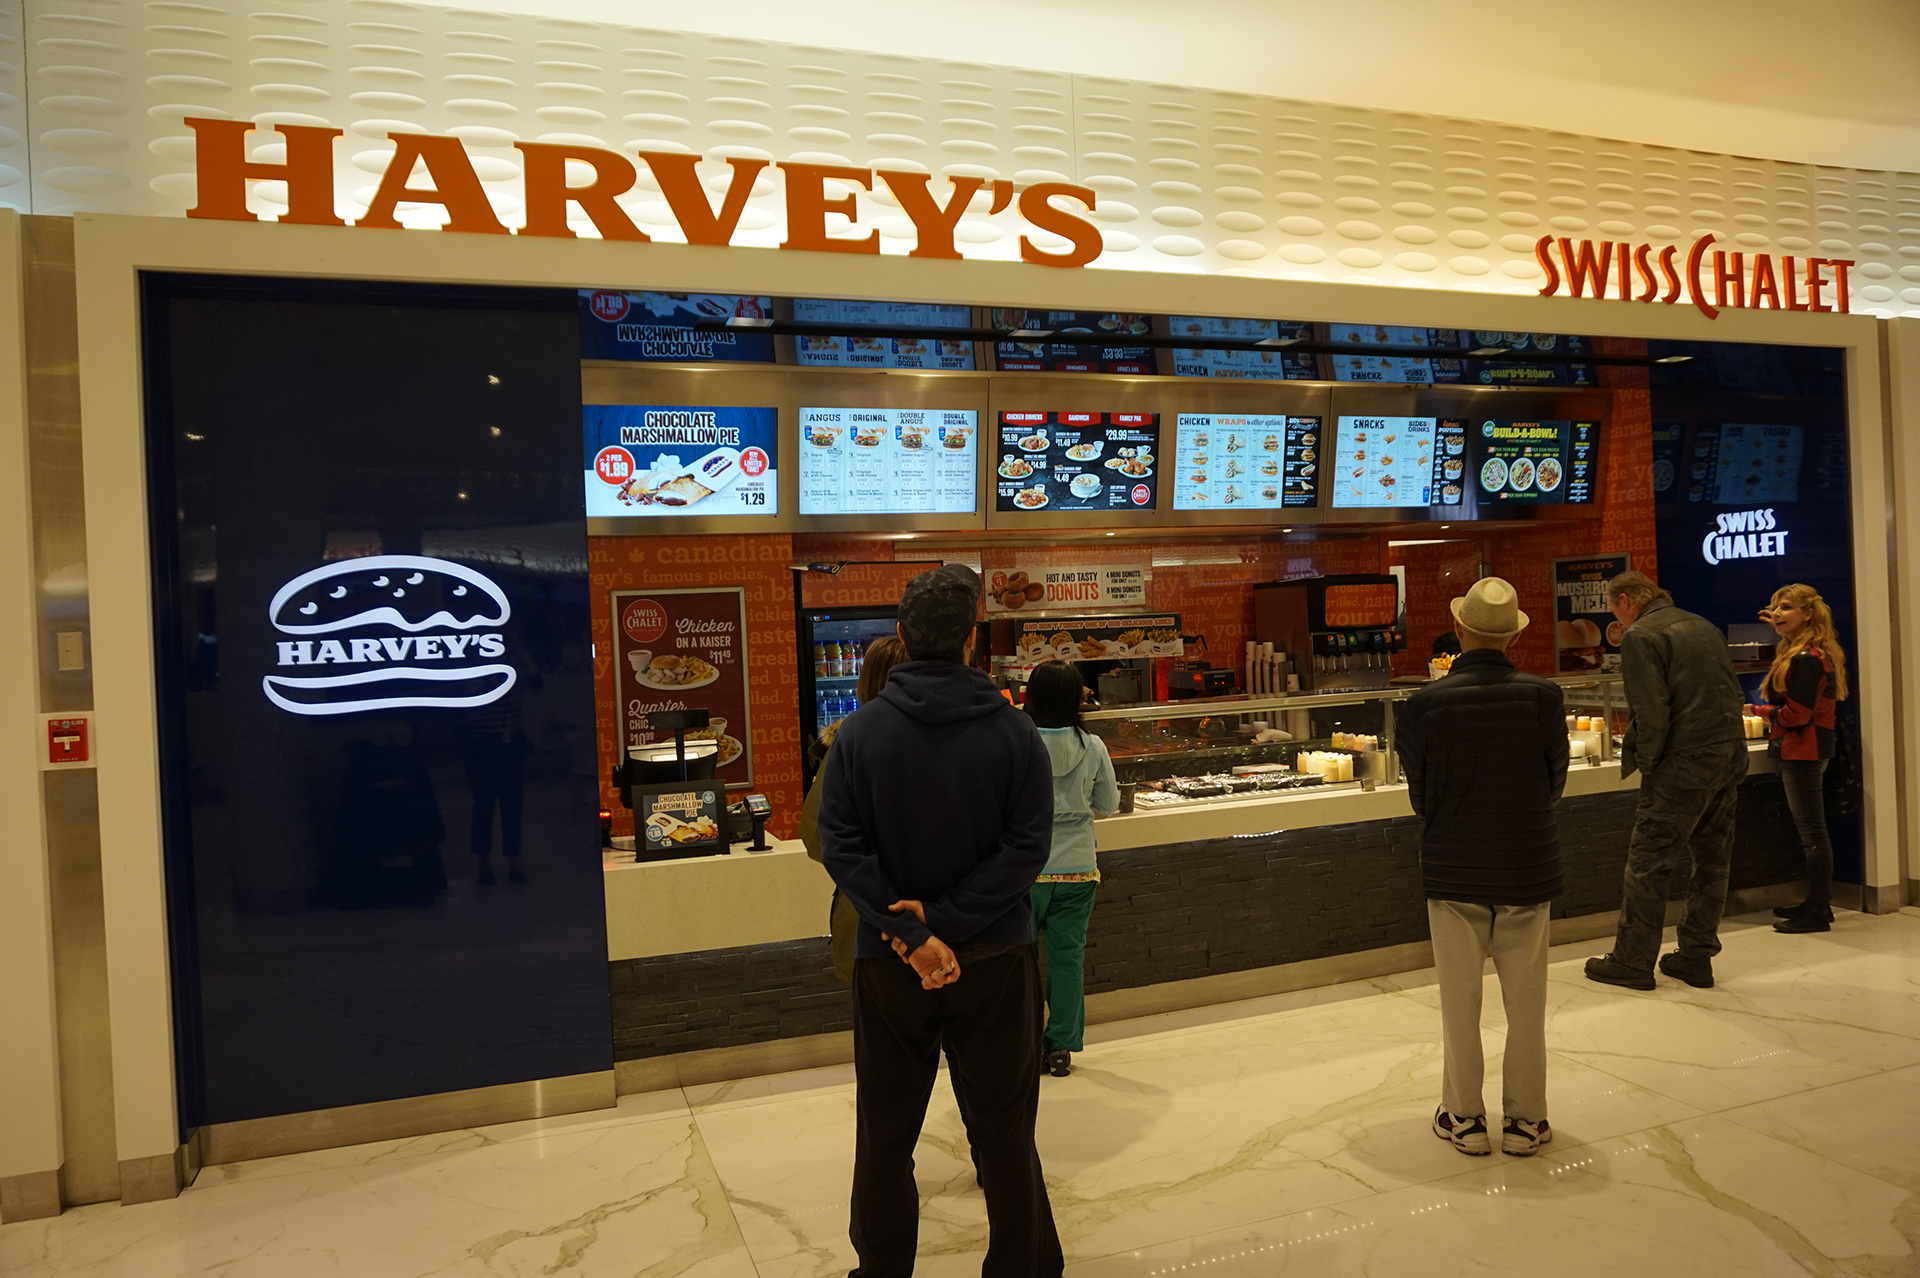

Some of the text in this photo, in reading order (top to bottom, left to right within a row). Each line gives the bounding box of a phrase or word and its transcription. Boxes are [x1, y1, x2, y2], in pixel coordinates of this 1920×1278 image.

[184, 117, 1103, 268] HARVEY'S
[1535, 233, 1855, 320] SWISS CHALET
[646, 412, 715, 429] CHOCOLATE
[809, 413, 841, 422] ANGUS
[852, 414, 888, 422] ORIGINAL
[1179, 417, 1211, 426] CHICKEN
[1353, 419, 1385, 429] SNACKS
[621, 429, 739, 444] MARSHMALLOW PIE
[1105, 429, 1127, 440] $29.99
[1493, 427, 1558, 438] BUILD-A-BOWL!
[600, 461, 628, 477] $1.99
[740, 492, 765, 505] $1.29
[1715, 507, 1777, 534] SWISS
[1575, 531, 1656, 555] canadian
[1702, 530, 1788, 565] CHALET
[656, 536, 793, 565] canadian
[1569, 560, 1614, 571] HARVEY'S
[642, 568, 703, 584] famous
[708, 565, 768, 584] pickles.
[838, 565, 886, 585] daily.
[1046, 571, 1098, 583] HOT AND TASTY
[1121, 570, 1141, 578] DONUTS
[1581, 572, 1602, 581] SWISS
[1046, 582, 1099, 602] DONUTS
[1106, 586, 1110, 594] 8
[1122, 585, 1142, 593] DONUTS
[1334, 583, 1378, 593] toasted
[1557, 580, 1609, 597] MUSHRO
[1180, 593, 1233, 609] harvey's
[633, 609, 657, 618] SWISS
[1215, 610, 1237, 620] buns
[627, 616, 663, 630] CHALET
[675, 618, 735, 634] Chicken
[1024, 617, 1175, 631] AND DON'T FORGET ONE OF OUR DELICIOUS SIDES!
[676, 635, 731, 649] ON A KAISER
[276, 633, 505, 665] HARVEY'S
[629, 719, 650, 730] CHIC
[659, 792, 696, 804] CHOCOLATE
[653, 801, 703, 812] MARSHMALLOW
[685, 809, 698, 818] PIE
